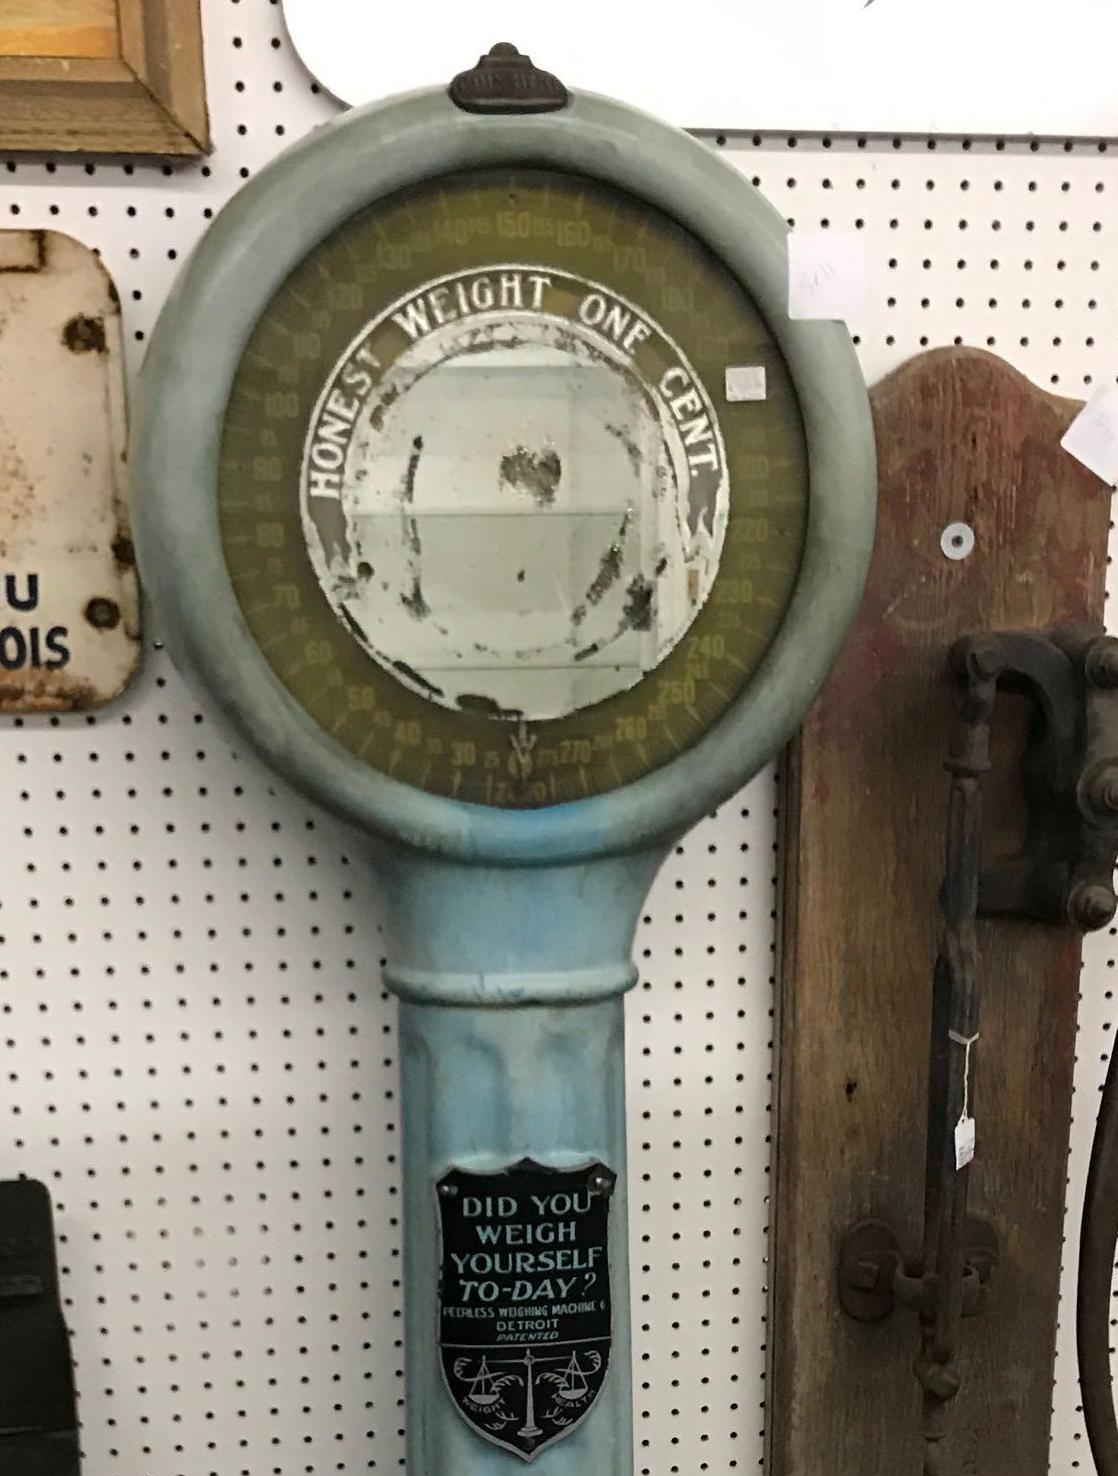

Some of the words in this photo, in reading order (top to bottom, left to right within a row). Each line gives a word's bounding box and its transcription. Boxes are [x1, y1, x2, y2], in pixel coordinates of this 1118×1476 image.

[309, 341, 382, 499] HONEST
[391, 272, 552, 341] WEIGHT
[6, 573, 39, 612] U
[0, 625, 71, 671] OIS
[462, 1196, 518, 1217] DID
[531, 1192, 592, 1215] YOU
[475, 1220, 577, 1245] WEIGH
[450, 1246, 603, 1275] YOURSELF
[498, 1303, 549, 1318] WEIGHING
[551, 1300, 597, 1316] MACHINE
[496, 1318, 560, 1332] DETROIT
[496, 1330, 560, 1342] PATENTED
